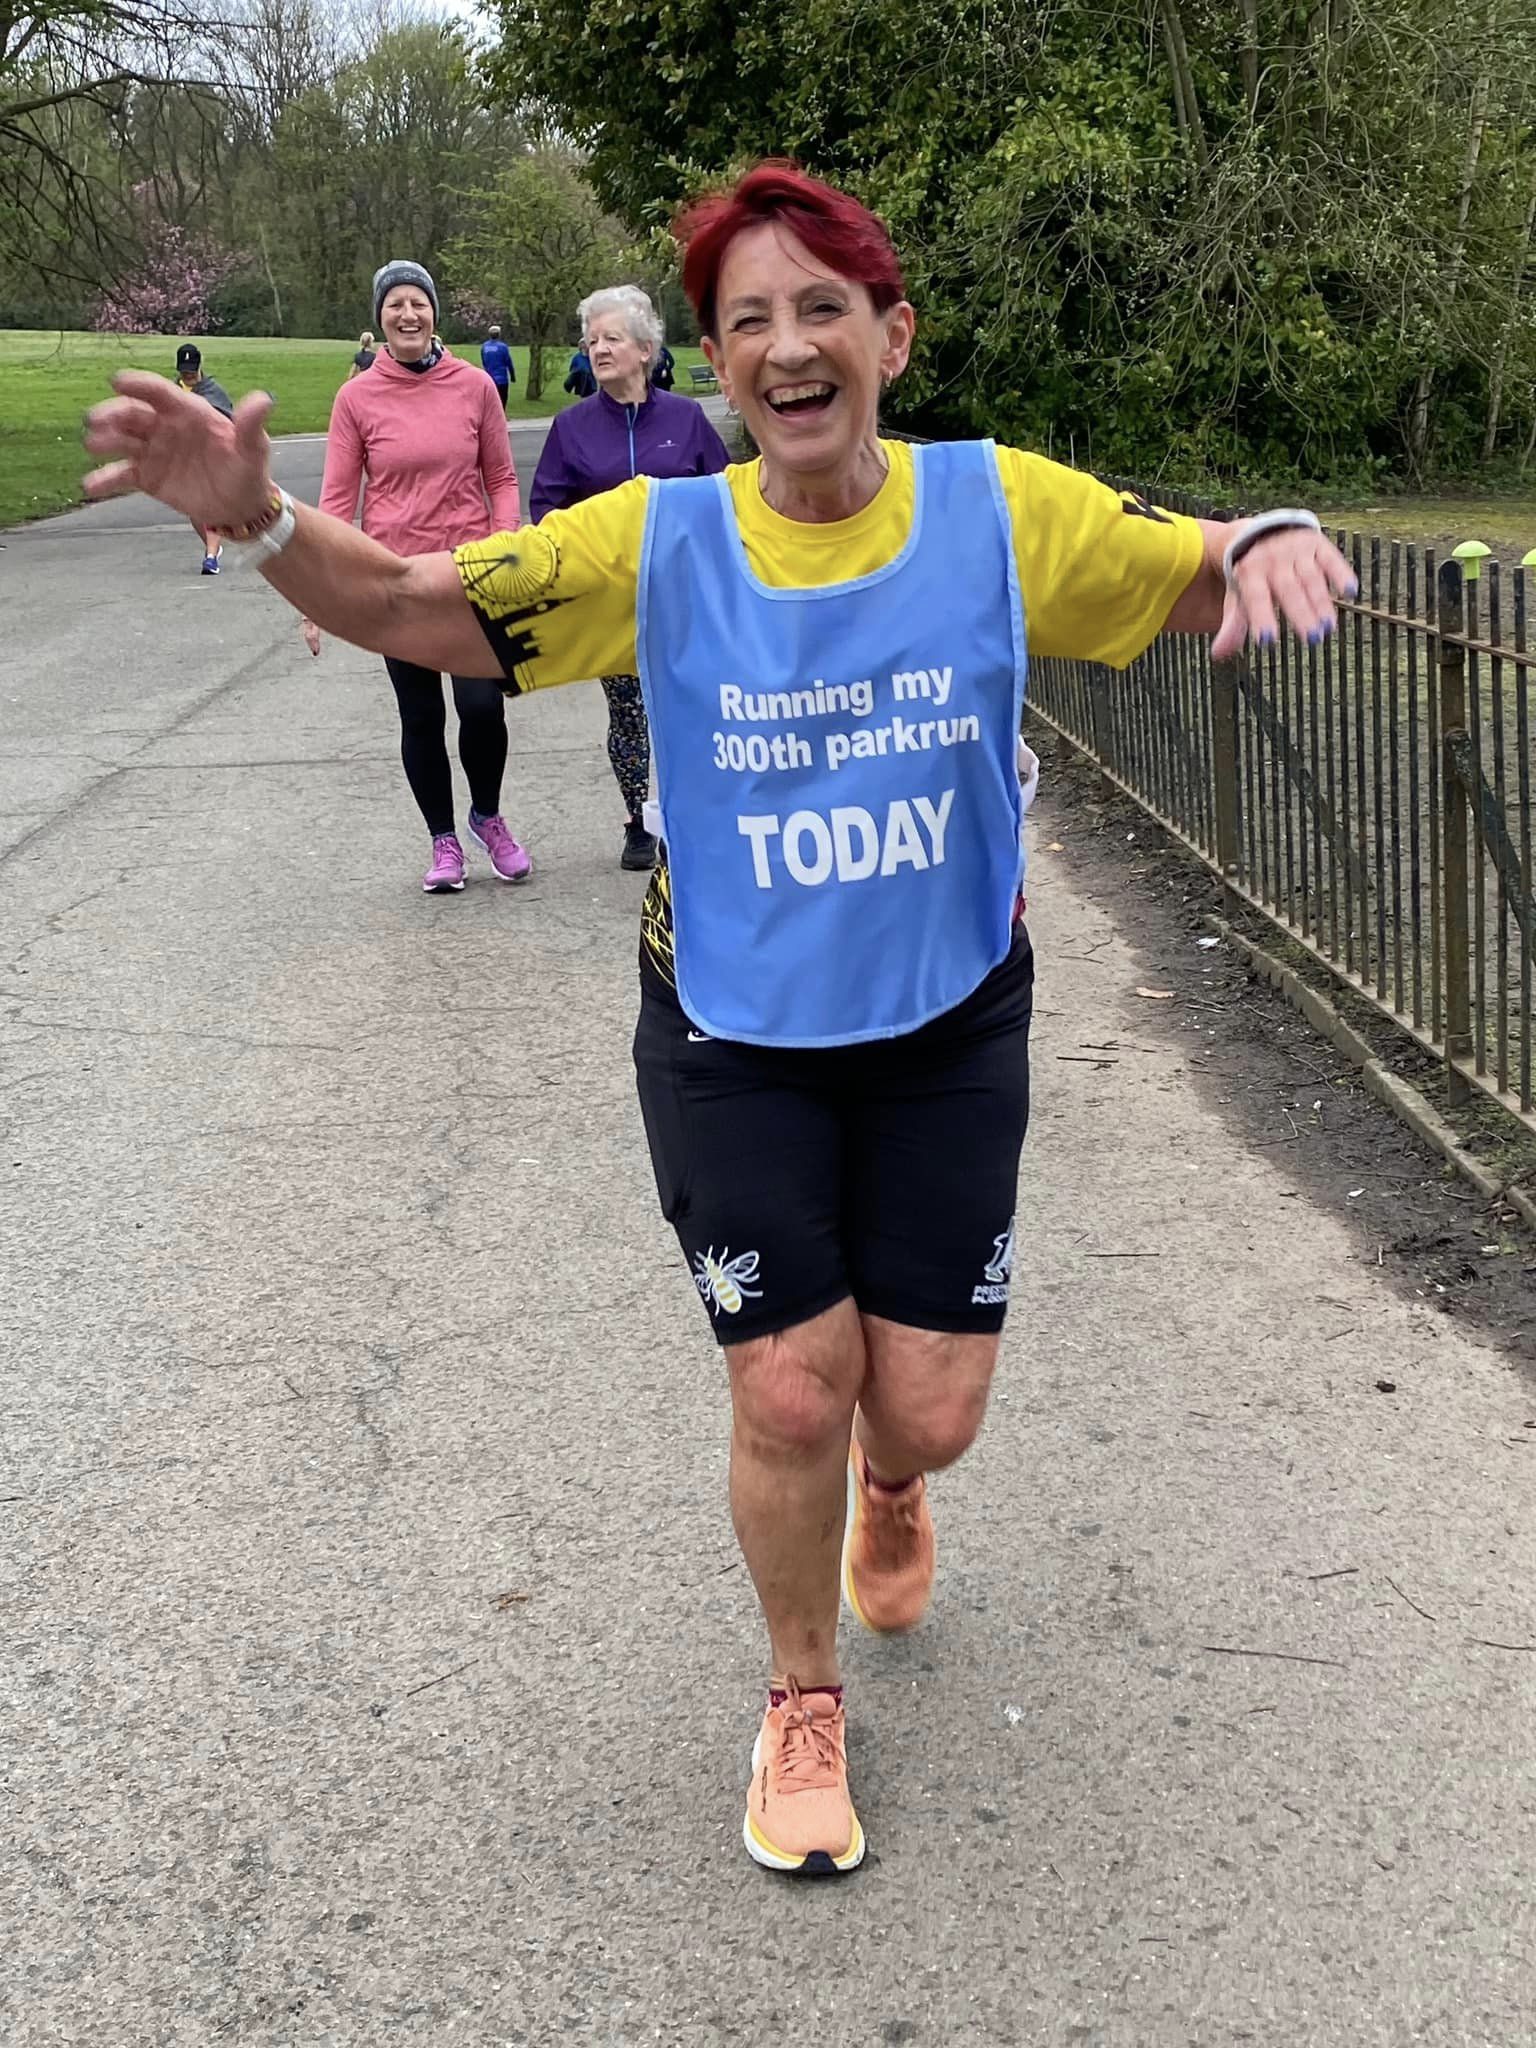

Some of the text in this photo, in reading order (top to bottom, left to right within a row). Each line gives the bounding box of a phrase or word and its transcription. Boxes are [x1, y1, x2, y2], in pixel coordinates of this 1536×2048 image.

[719, 666, 953, 721] Running my
[712, 714, 980, 772] 300th parkrun
[737, 788, 955, 889] TODAY
